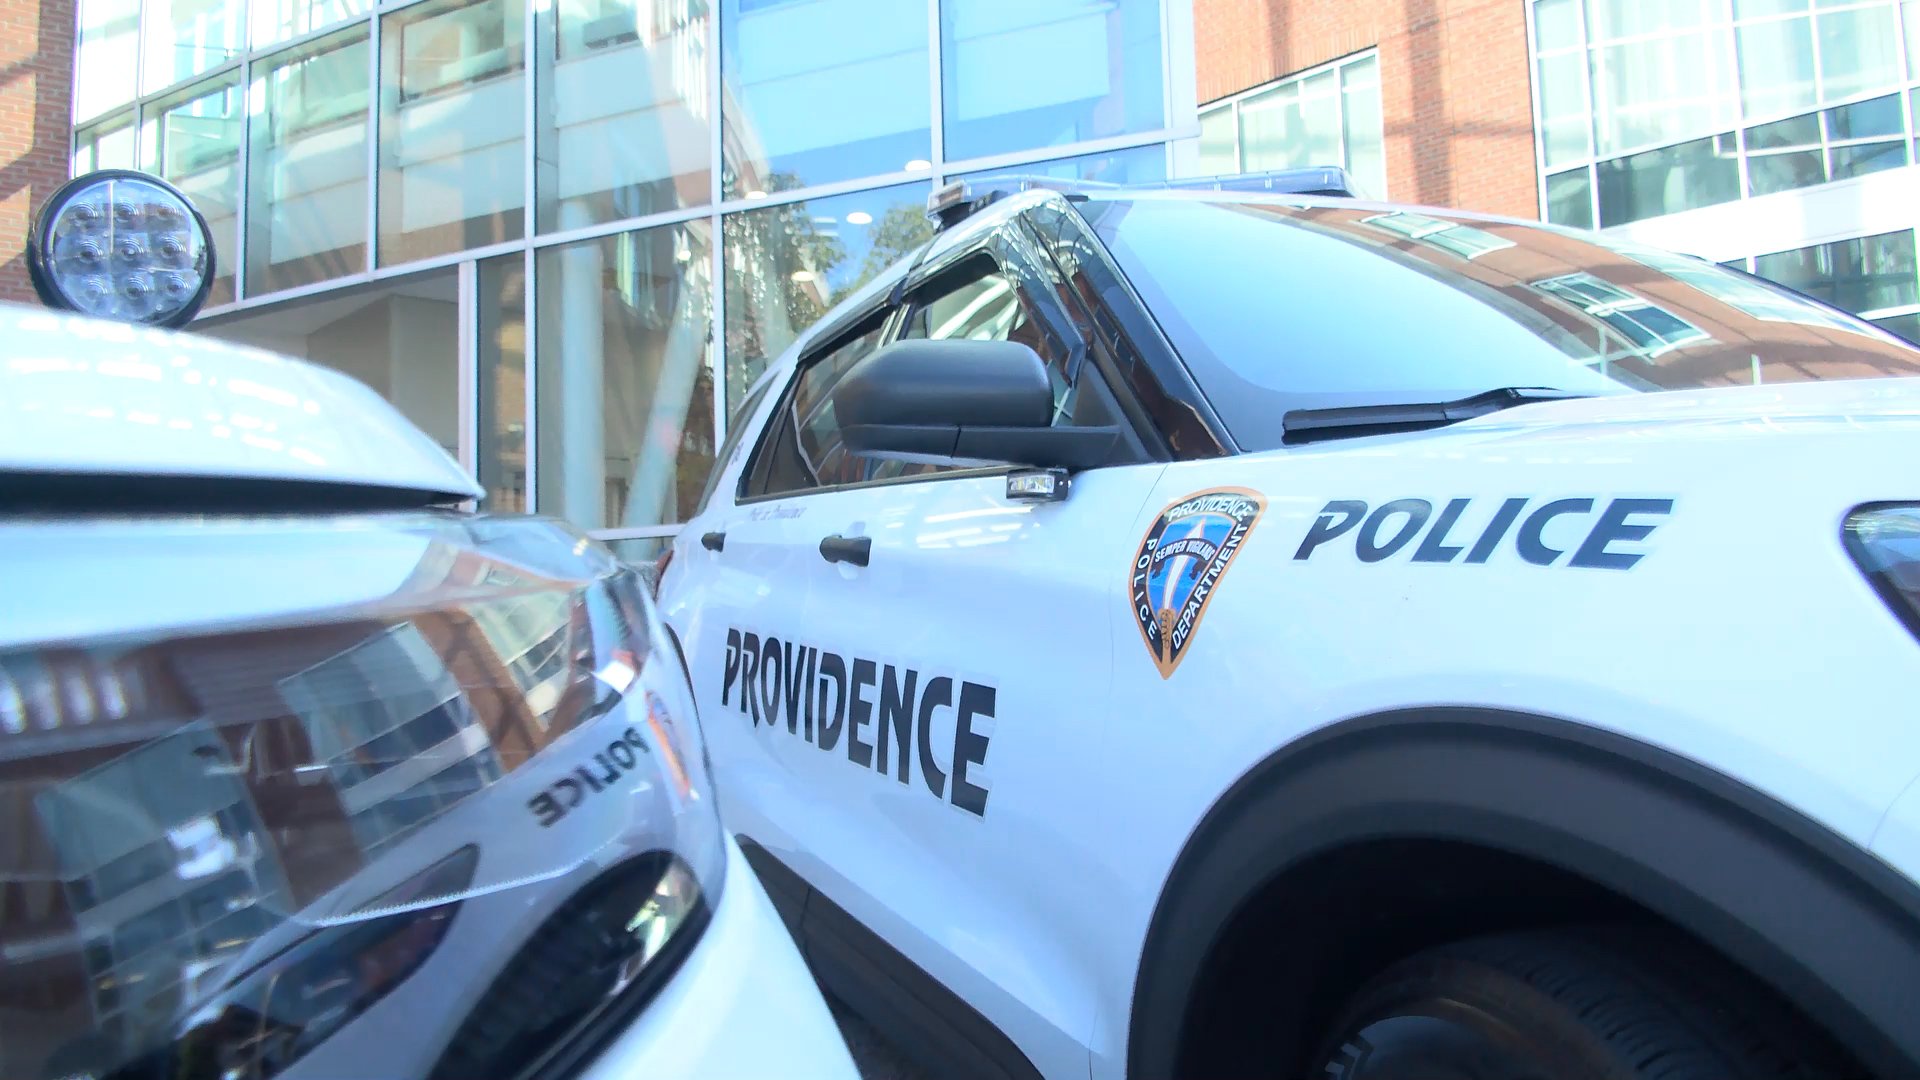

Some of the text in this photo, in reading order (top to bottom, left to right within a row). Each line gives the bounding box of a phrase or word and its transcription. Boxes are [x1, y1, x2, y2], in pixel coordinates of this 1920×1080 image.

[1154, 540, 1188, 563] SEMPER
[1168, 496, 1253, 522] PROVIDENCE
[1293, 498, 1674, 571] POLICE
[1133, 538, 1157, 640] POLICE
[1172, 523, 1248, 650] DEPARTMENT
[722, 628, 997, 817] PROVIDENCE
